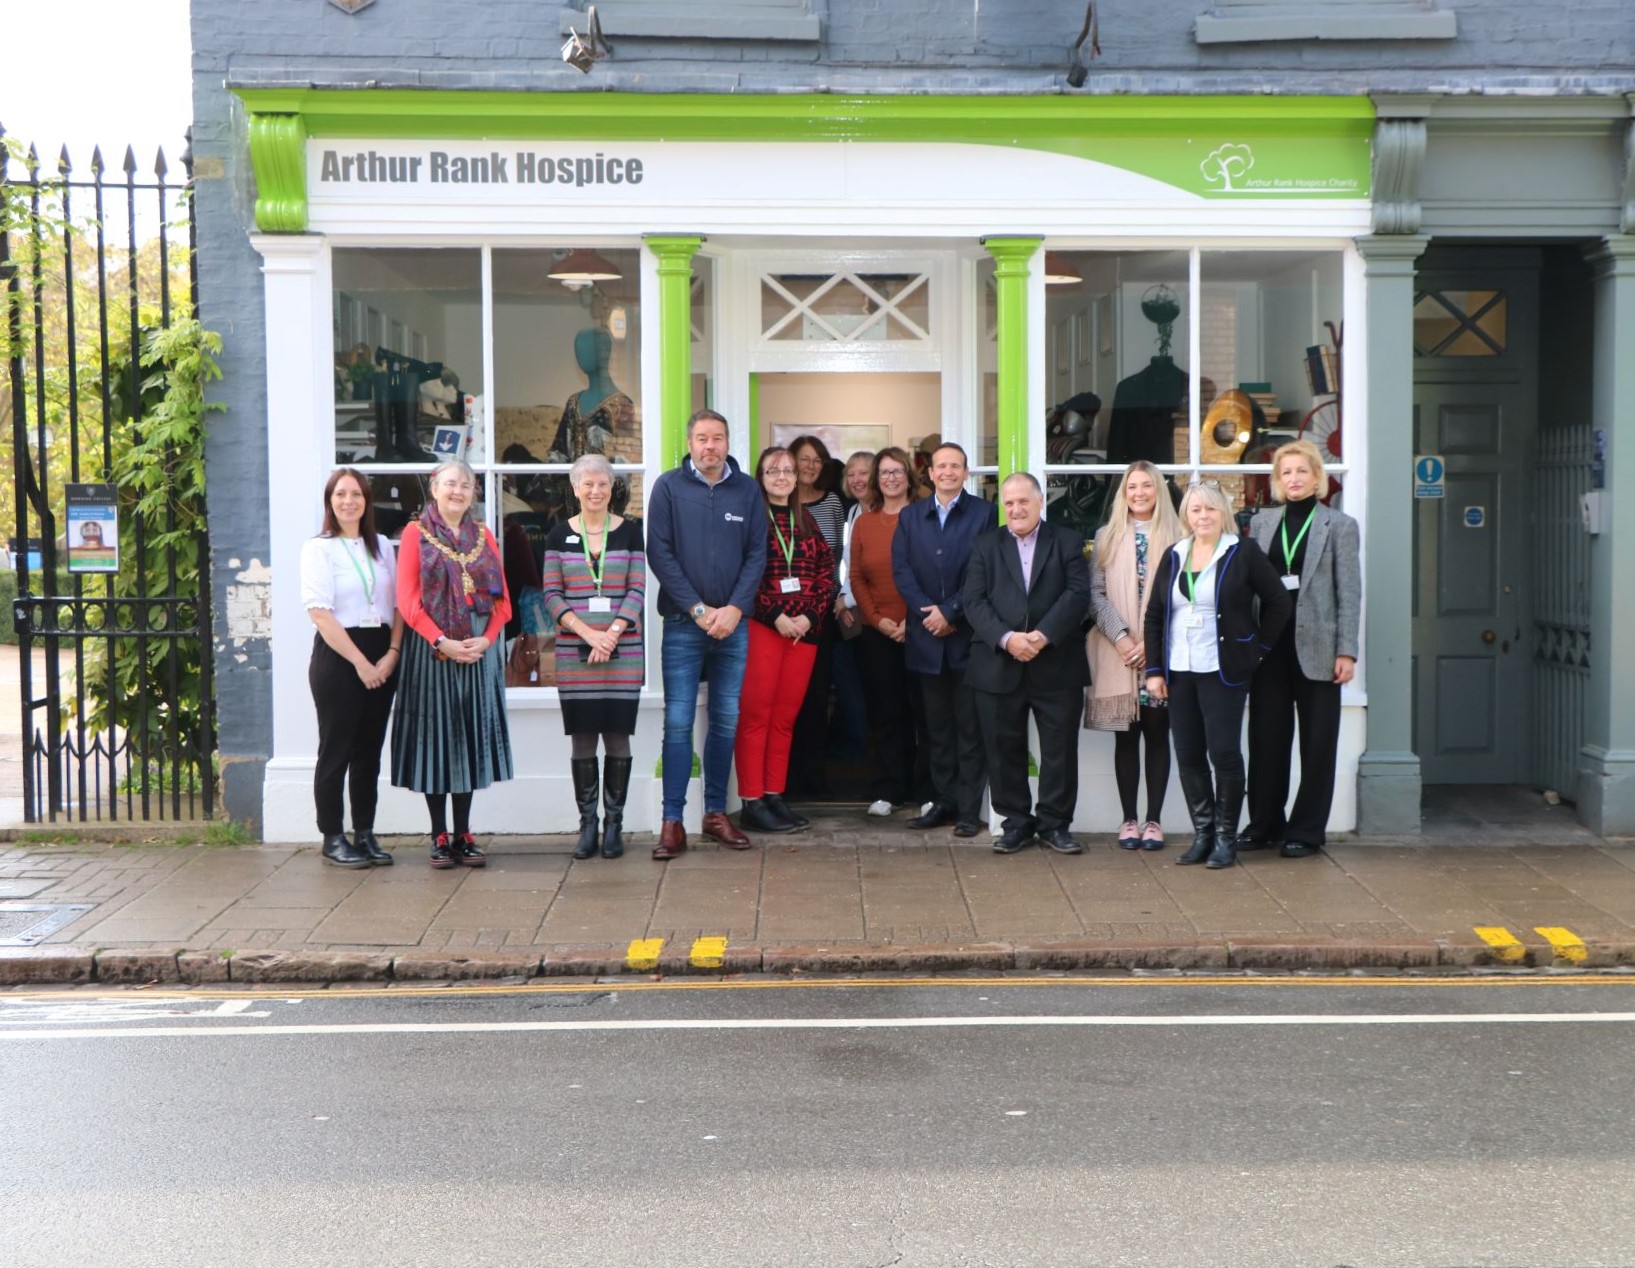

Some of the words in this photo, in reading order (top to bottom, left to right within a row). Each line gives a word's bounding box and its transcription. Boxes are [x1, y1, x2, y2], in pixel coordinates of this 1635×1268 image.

[320, 150, 422, 182] Arthur
[430, 151, 508, 184] Rank
[516, 152, 644, 187] Hospice
[1246, 179, 1271, 187] Arthur
[1274, 179, 1293, 187] Rank
[1295, 179, 1327, 188] Hospice
[1328, 179, 1358, 188] Charity
